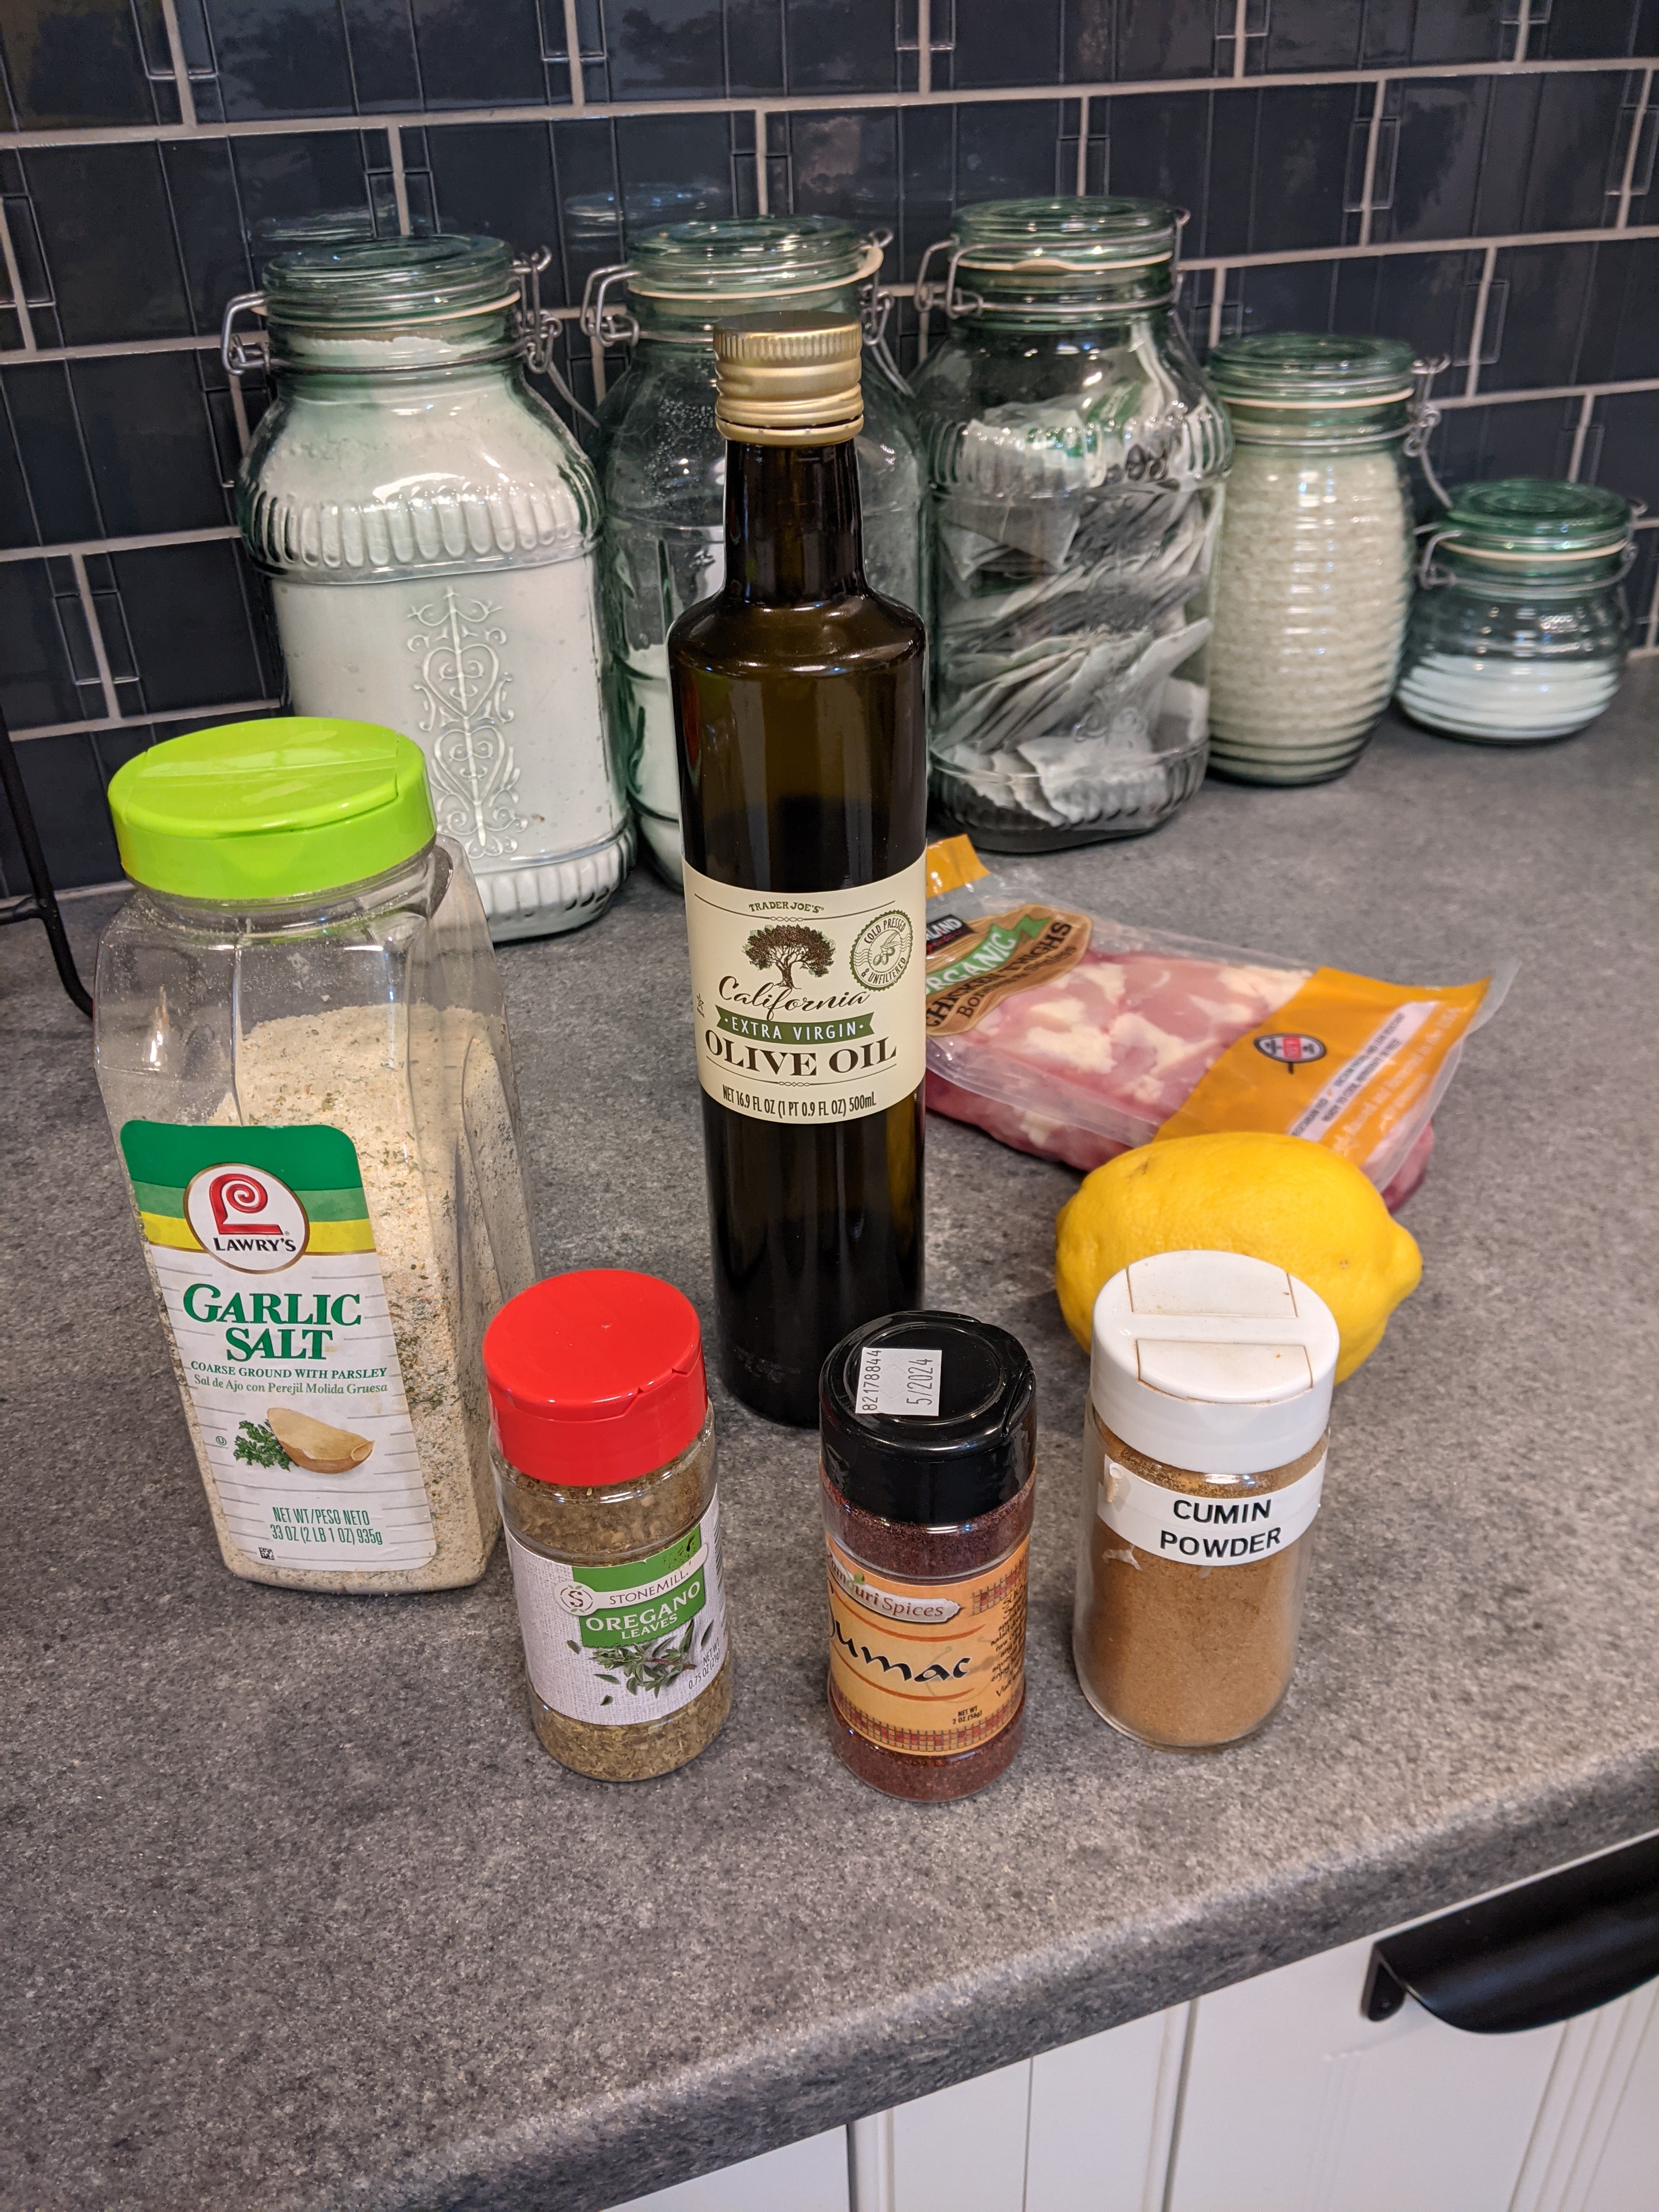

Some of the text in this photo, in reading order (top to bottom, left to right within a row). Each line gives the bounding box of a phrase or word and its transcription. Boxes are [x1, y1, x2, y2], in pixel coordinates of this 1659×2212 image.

[748, 901, 822, 913] TRADER JOE'S
[864, 917, 906, 944] COLD PRESSED
[861, 957, 906, 984] & UNFILTERED
[926, 933, 1017, 995] RGANIC
[719, 975, 871, 1021] California
[732, 1016, 856, 1041] EXTRA VIRGIN
[706, 1029, 897, 1076] OLIVE OIL
[723, 1084, 877, 1119] NET 16.9 FL OZ (1 PT 0.9 FL OZ) 500mL
[213, 1237, 296, 1252] LAWRY'S
[183, 1283, 362, 1326] GARLIC
[225, 1327, 334, 1362] SALT
[191, 1361, 387, 1379] COARSE GROUND WITH PARSLEY
[862, 1350, 882, 1410] 82178844
[906, 1358, 933, 1405] 5/2024
[194, 1374, 210, 1386] Sal
[212, 1378, 223, 1388] de
[225, 1380, 244, 1392] Ajo
[268, 1383, 303, 1395] Perejil
[306, 1383, 344, 1394] Molida
[347, 1383, 388, 1394] Gruesa
[272, 1507, 370, 1525] NET WT/PESO NETO
[1173, 1499, 1271, 1524] CUMIN
[270, 1524, 383, 1545] 33 OZ (2 LB 1 OZ) 935g
[1160, 1527, 1282, 1558] POWDER
[610, 1571, 687, 1605] STONEMILL
[585, 1581, 701, 1631] OREGANO
[882, 1597, 944, 1616] Spices
[621, 1613, 678, 1640] LEAVES
[703, 1637, 719, 1666] NET WT
[689, 1672, 702, 1690] 0.75
[702, 1663, 709, 1678] OZ
[958, 1709, 968, 1717] NET
